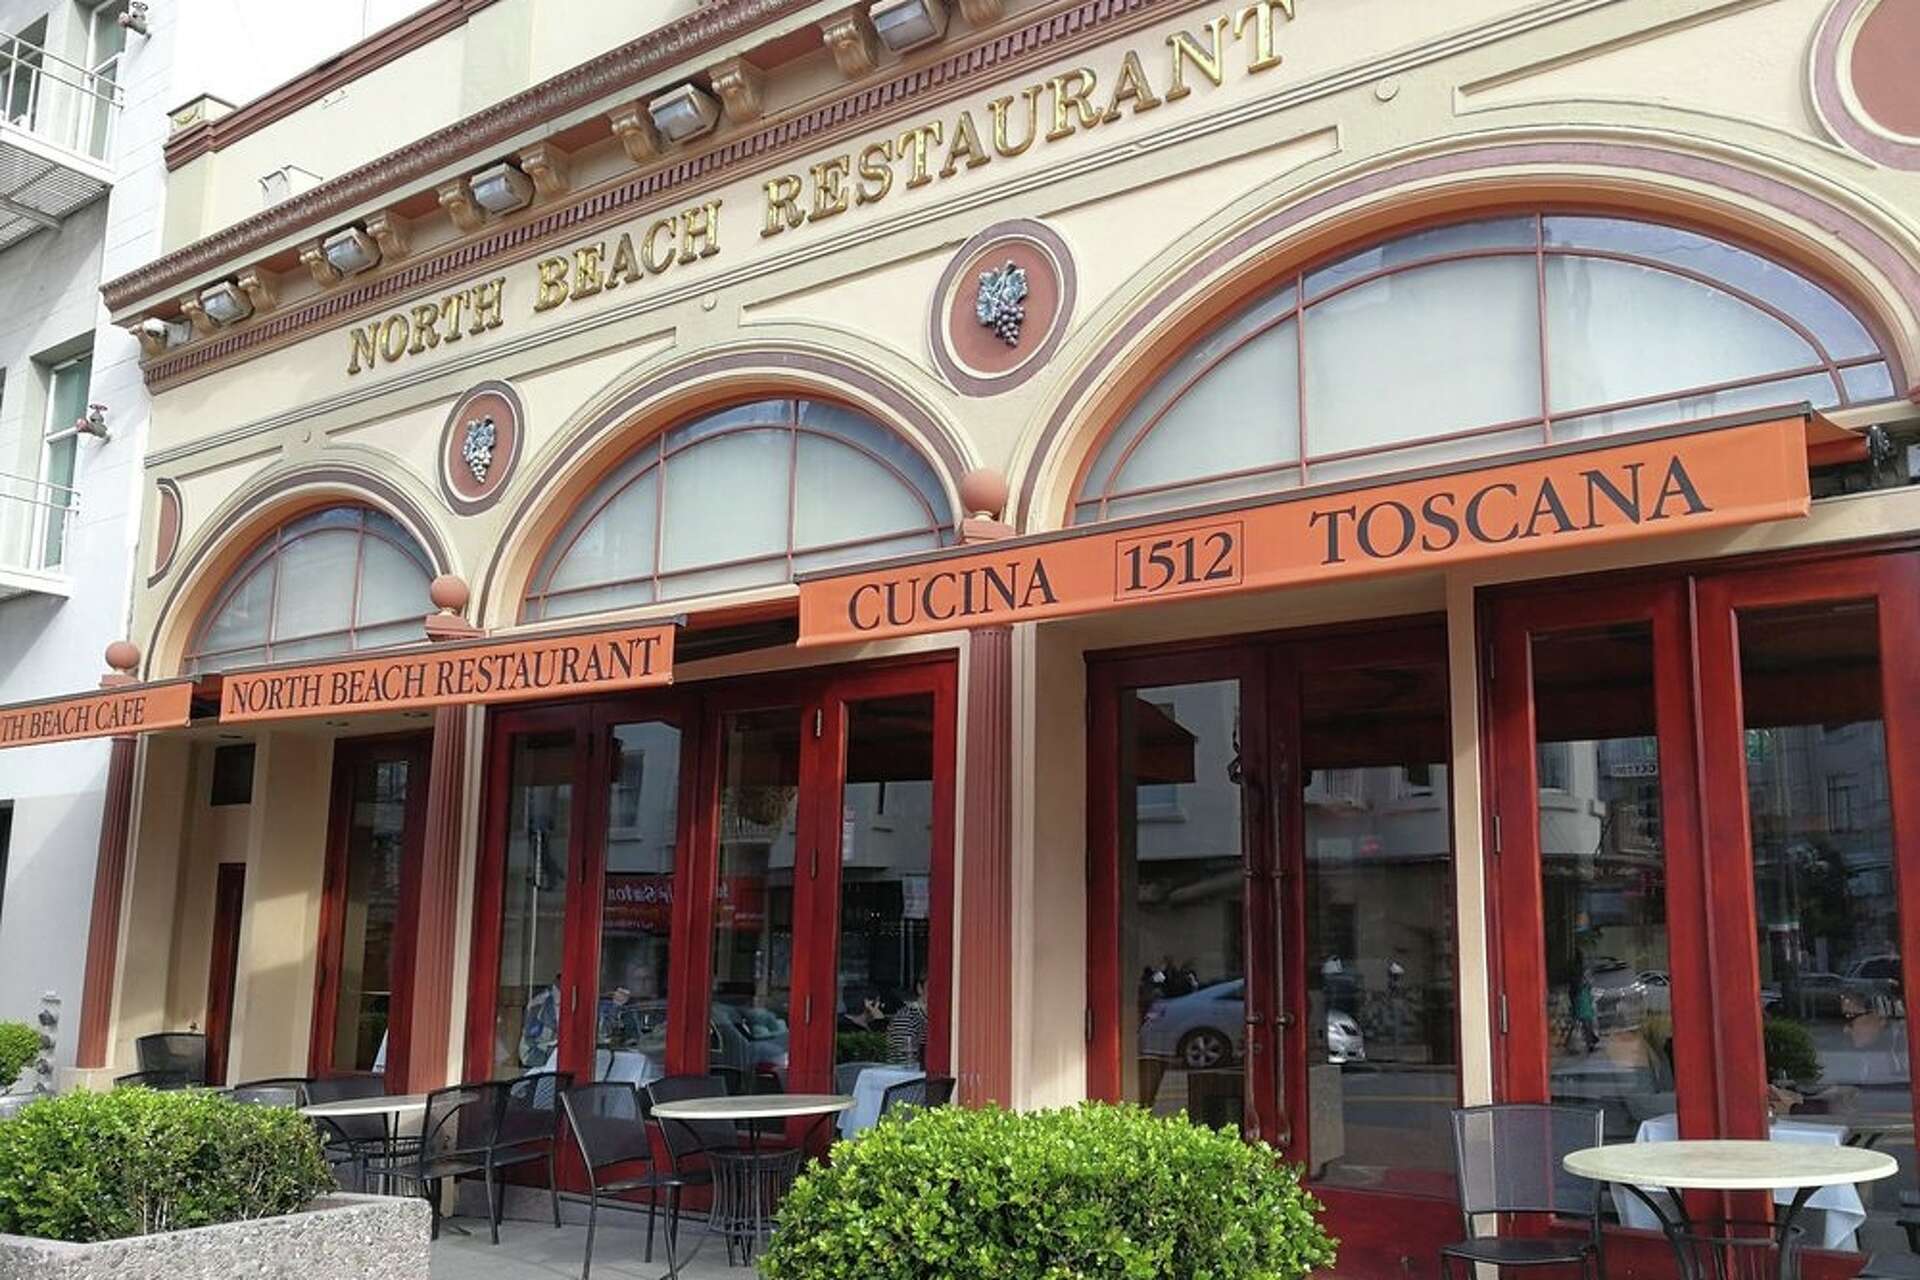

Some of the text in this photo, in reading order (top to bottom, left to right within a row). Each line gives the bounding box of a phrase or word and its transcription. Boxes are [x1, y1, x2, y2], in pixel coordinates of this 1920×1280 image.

[347, 0, 1295, 375] NORTH BEACH RESTAURANT
[848, 455, 1713, 631] CUCINA 1512 TOSCANA
[29, 704, 93, 739] BEACH
[95, 696, 147, 730] CAFE
[228, 635, 662, 714] NORTH BEACH RESTAURANT
